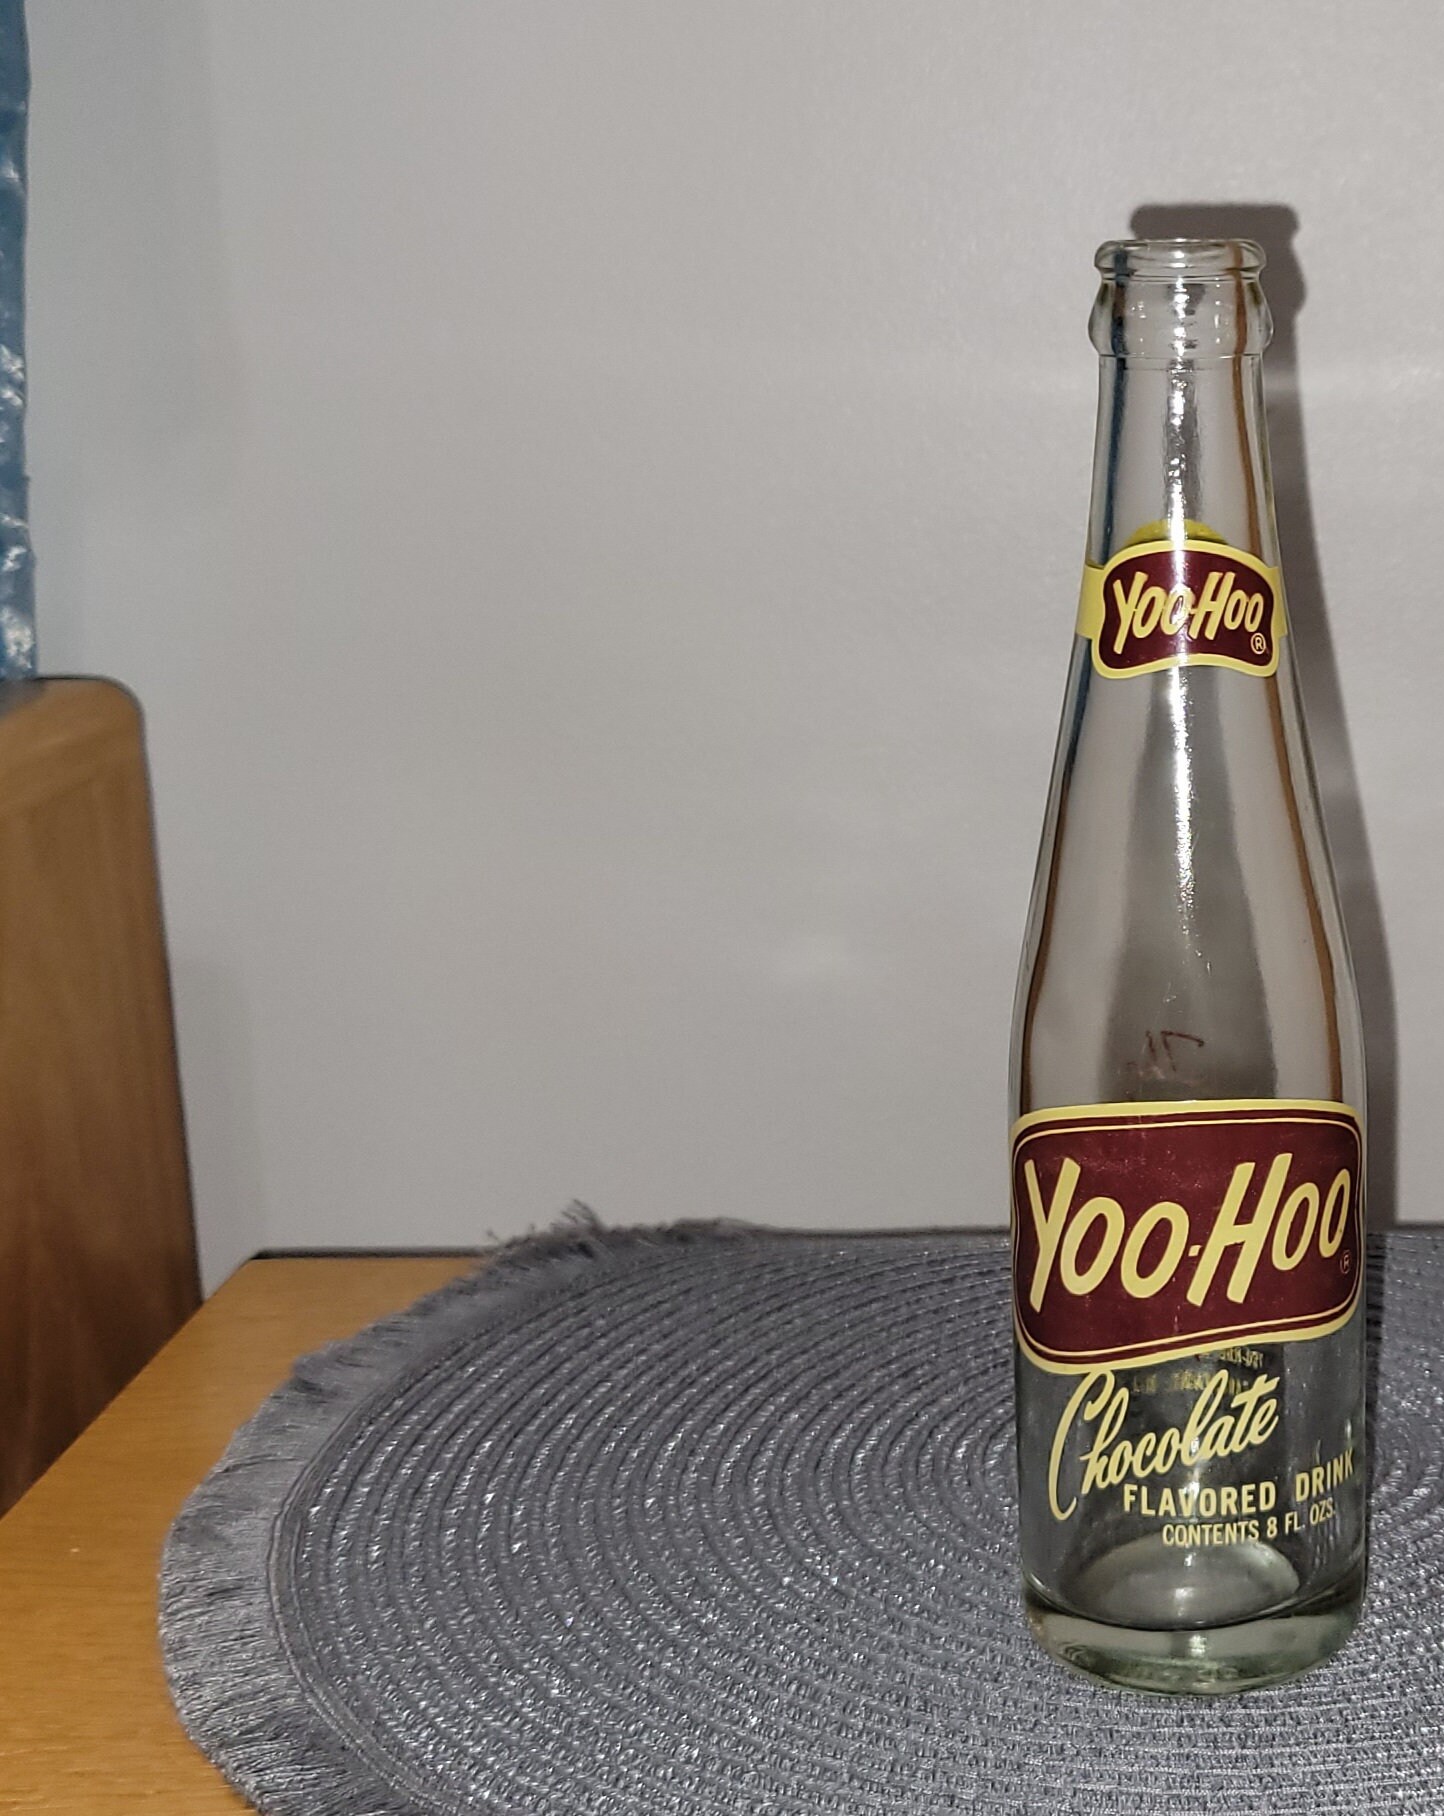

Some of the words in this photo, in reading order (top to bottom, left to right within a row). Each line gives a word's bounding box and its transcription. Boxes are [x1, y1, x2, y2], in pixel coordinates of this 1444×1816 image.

[1049, 1369, 1280, 1521] Chocolate
[1122, 1481, 1277, 1518] FLAVORED
[1295, 1447, 1354, 1502] DRINK
[1162, 1520, 1260, 1547] CONTENTS
[1266, 1516, 1278, 1539] 8
[1284, 1511, 1307, 1536] FL.
